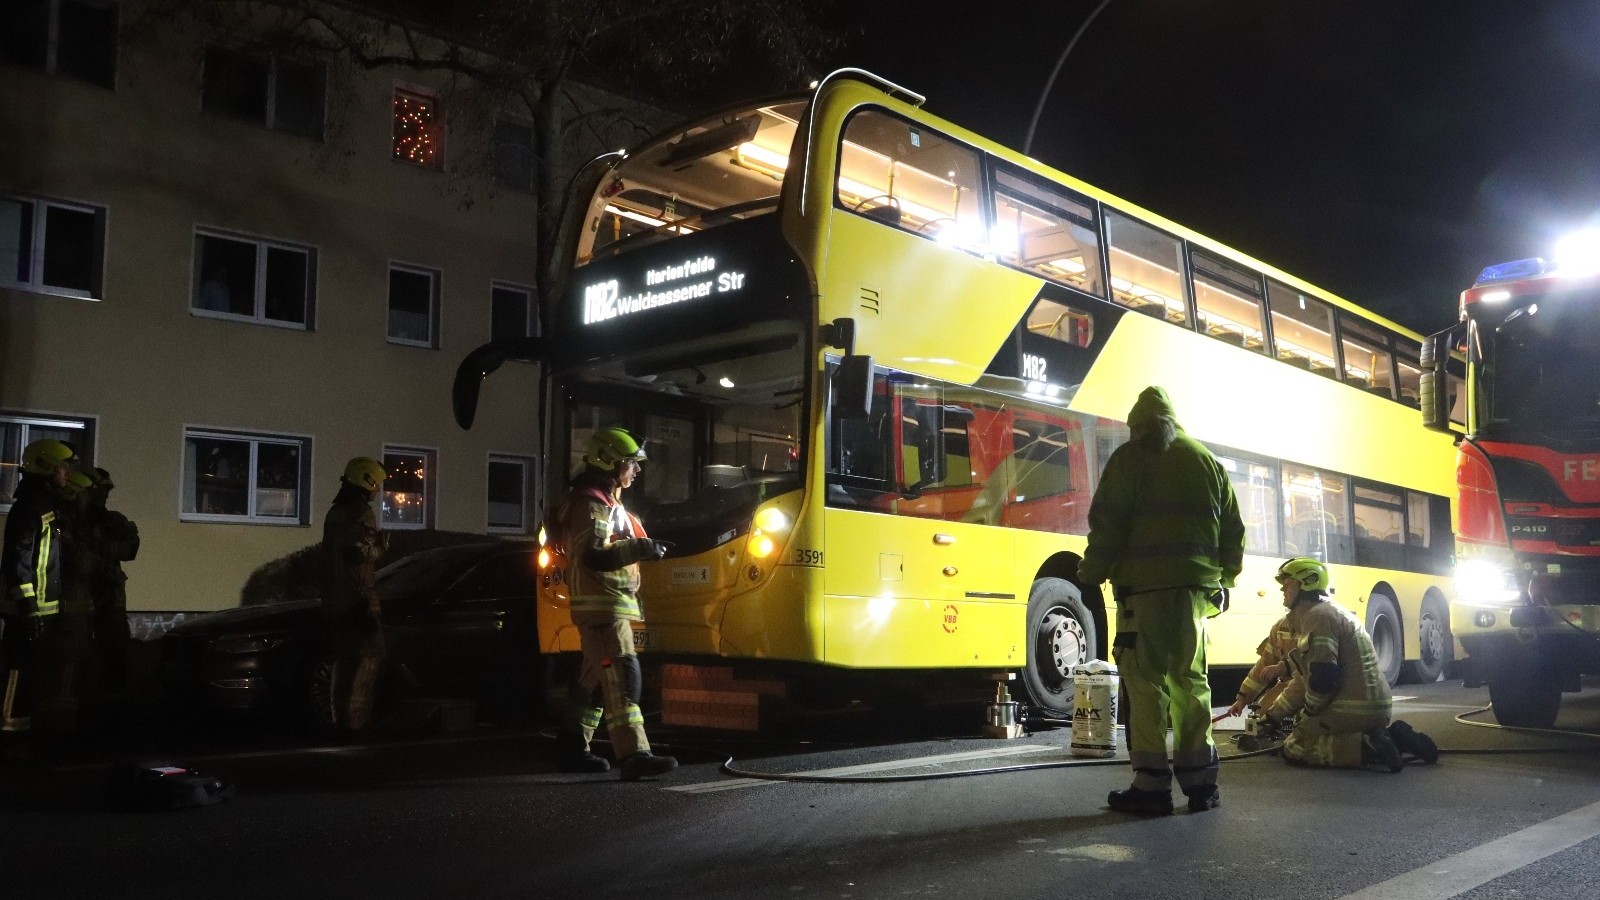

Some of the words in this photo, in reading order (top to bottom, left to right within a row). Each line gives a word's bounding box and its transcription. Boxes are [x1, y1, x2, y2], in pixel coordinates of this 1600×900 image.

[646, 256, 716, 286] Marienfelde
[617, 280, 713, 316] Waldsassener
[718, 271, 745, 292] Str
[1022, 353, 1047, 382] M82
[795, 549, 824, 565] 3591
[673, 571, 695, 580] BERLIN
[944, 614, 957, 624] VBB
